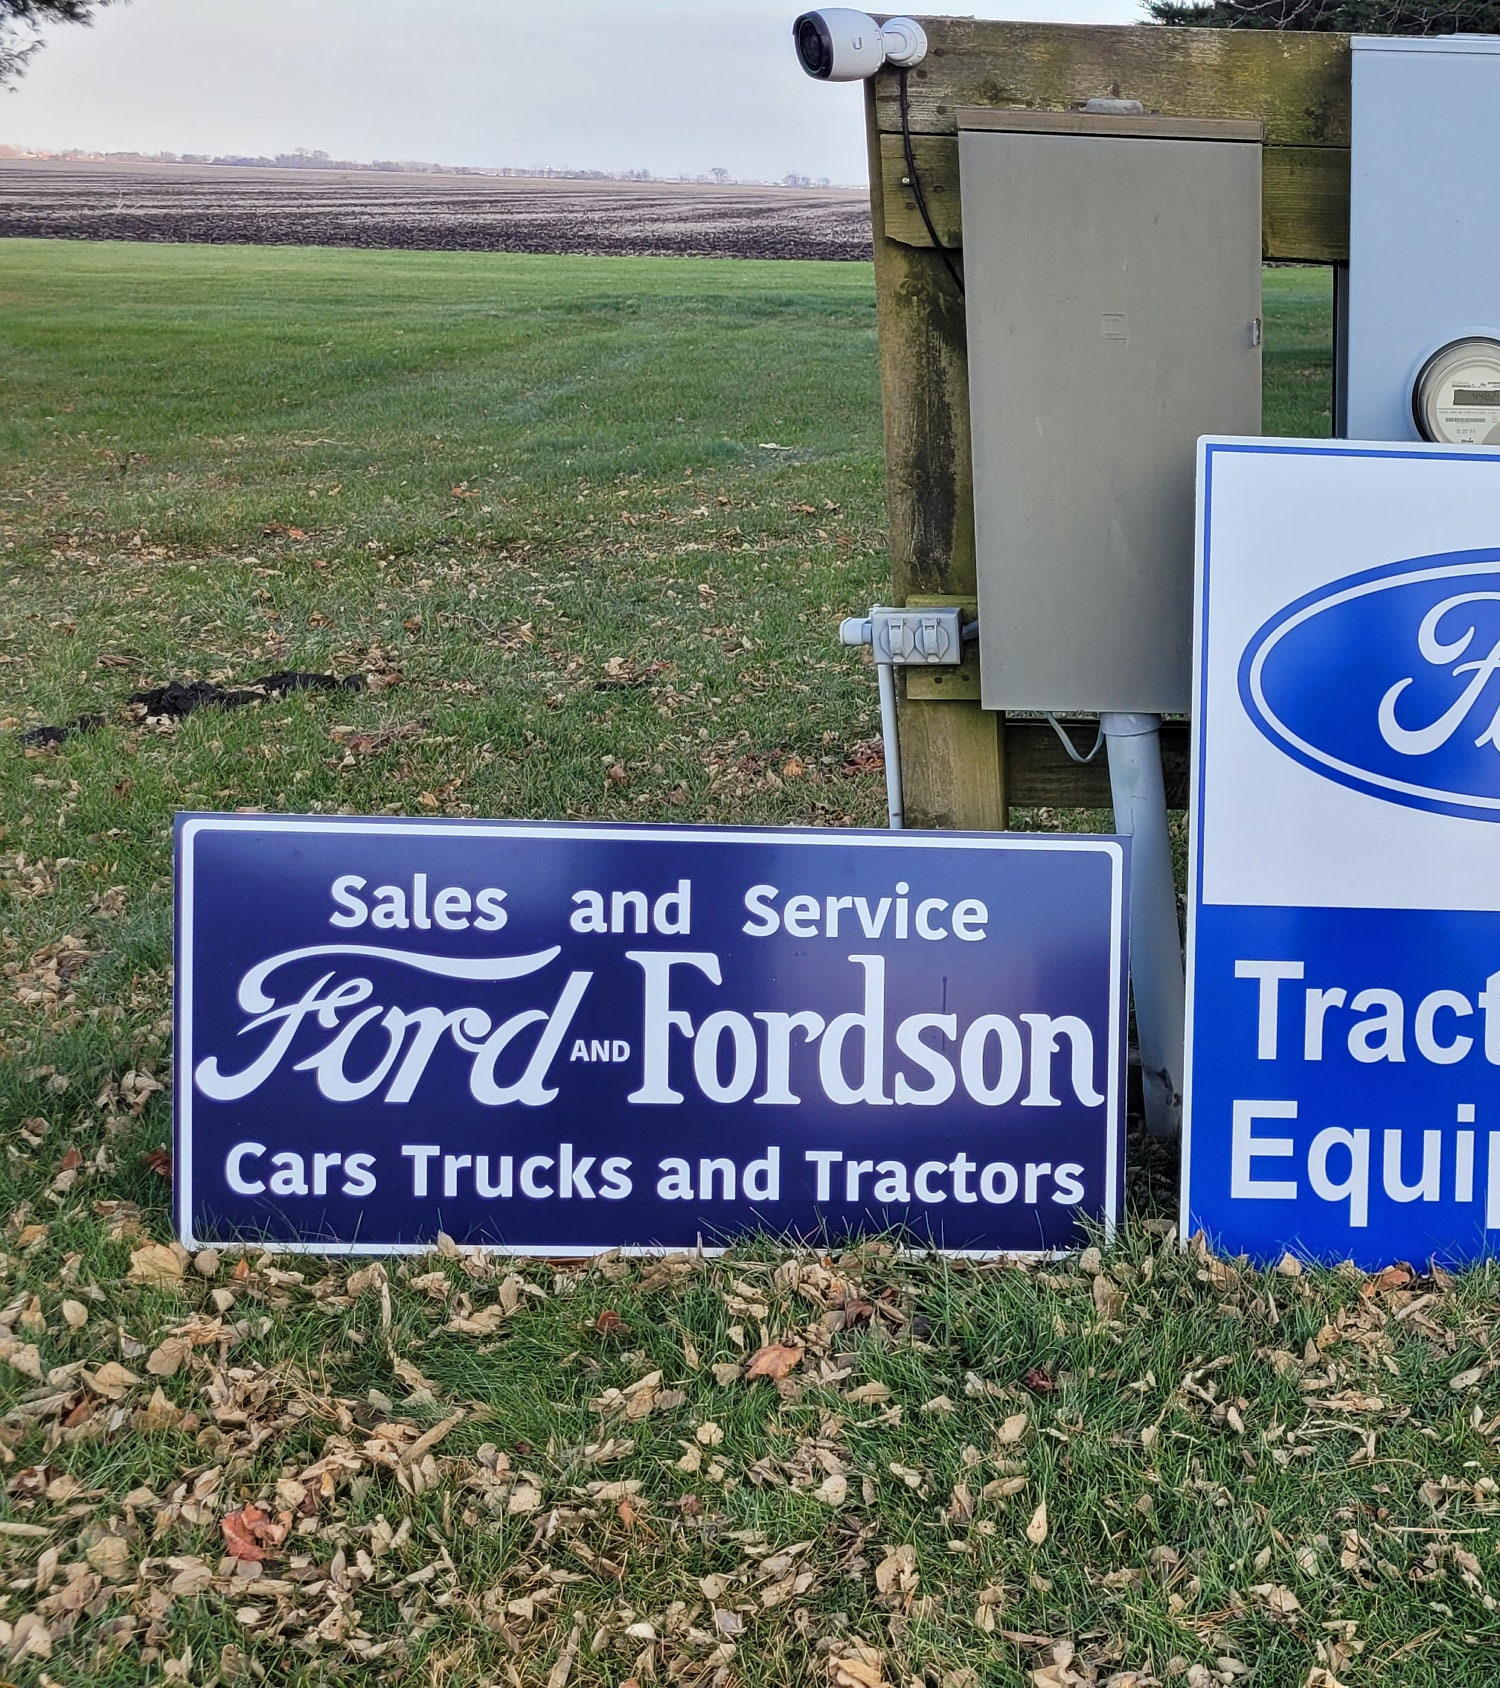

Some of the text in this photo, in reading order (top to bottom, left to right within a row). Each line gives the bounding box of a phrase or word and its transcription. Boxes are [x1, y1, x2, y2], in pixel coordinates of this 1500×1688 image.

[329, 872, 989, 941] Sales and Service
[195, 944, 1105, 1107] Ford AND Fordson
[225, 1142, 1086, 1205] Cars Trucks and Tractors
